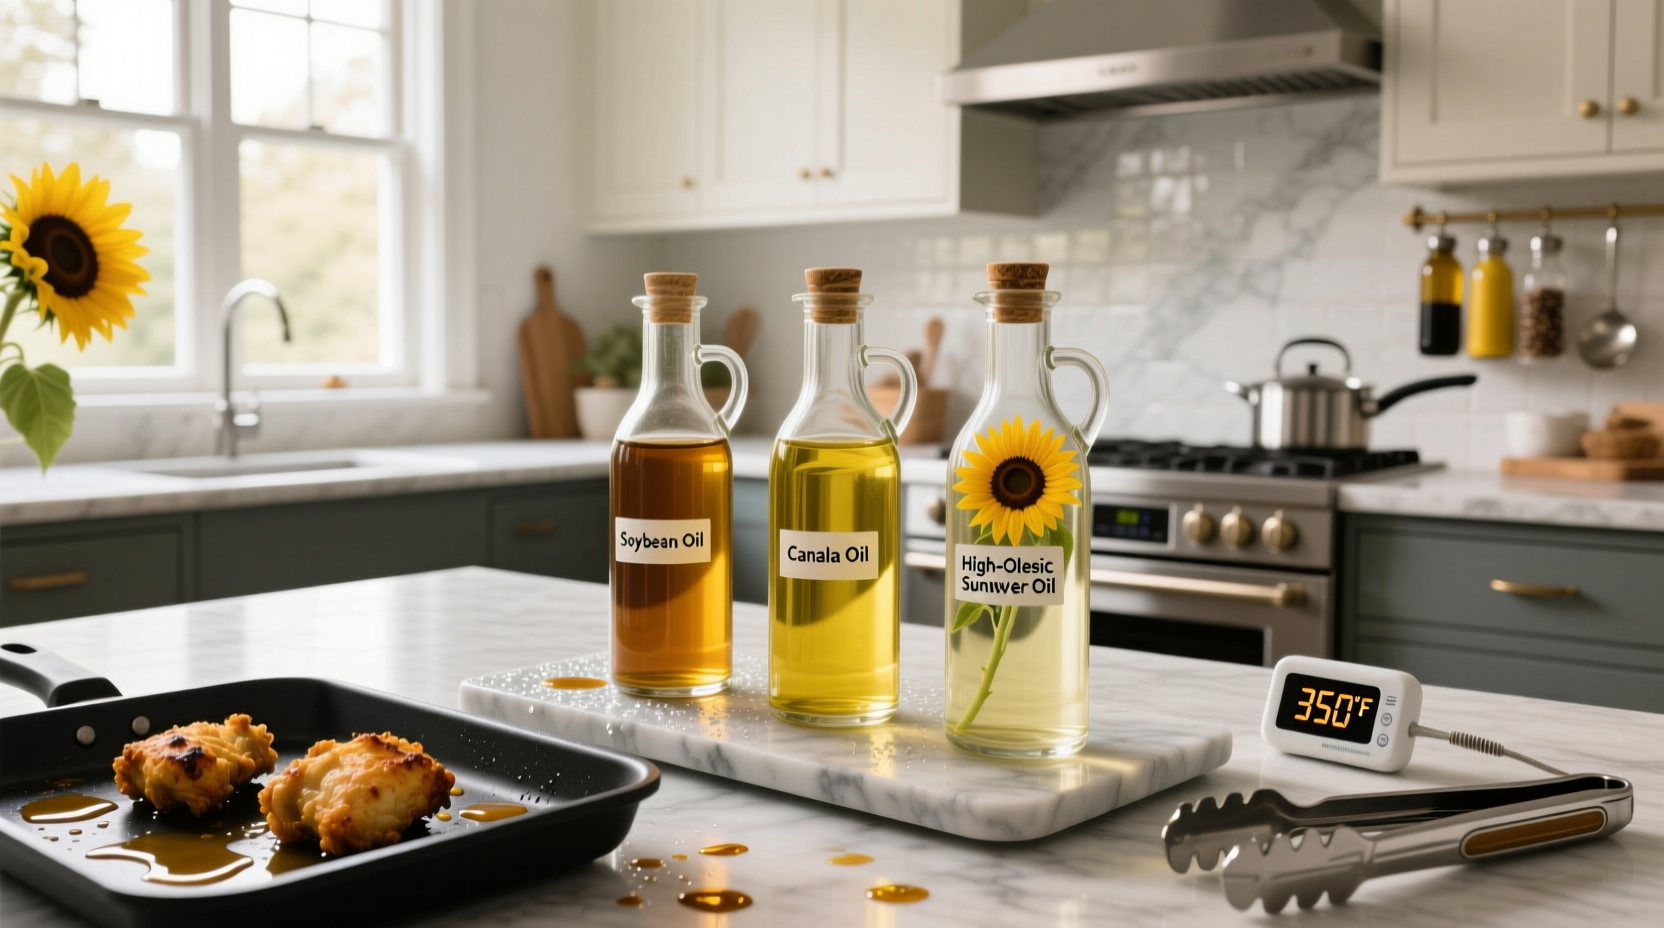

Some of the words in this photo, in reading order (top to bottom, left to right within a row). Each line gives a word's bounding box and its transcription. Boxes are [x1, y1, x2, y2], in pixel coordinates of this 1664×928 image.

[620, 531, 678, 552] Soybean
[682, 531, 704, 547] Oil
[787, 545, 840, 563] Canala
[845, 545, 869, 562] Oil
[962, 555, 1054, 576] High-Olesic
[1032, 577, 1056, 594] Oil
